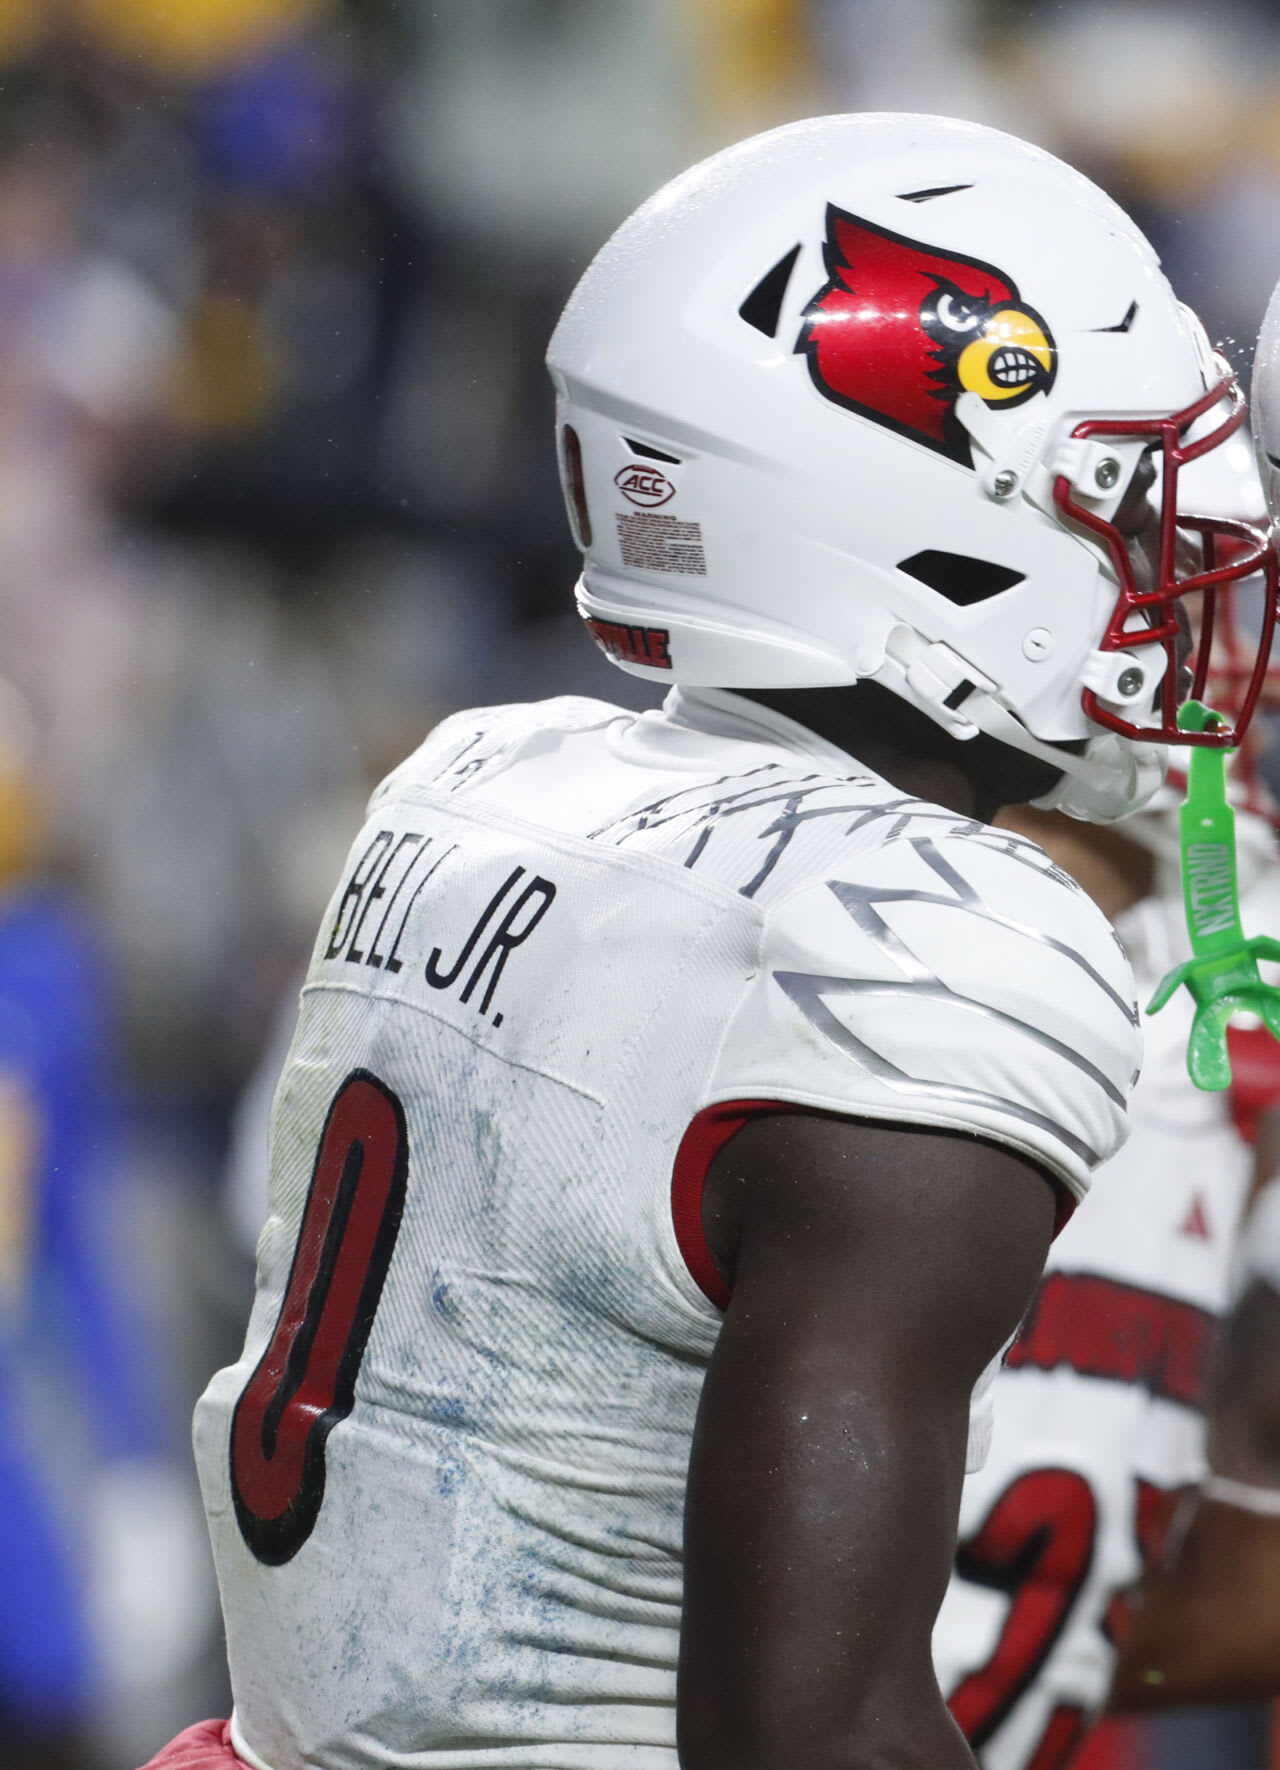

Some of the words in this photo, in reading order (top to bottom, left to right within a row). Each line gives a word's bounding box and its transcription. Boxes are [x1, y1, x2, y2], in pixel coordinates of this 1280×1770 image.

[622, 474, 666, 493] ACC
[324, 831, 460, 974] BELL
[425, 865, 557, 1029] JR.
[1187, 843, 1236, 936] NXTRND
[230, 1067, 410, 1567] 0
